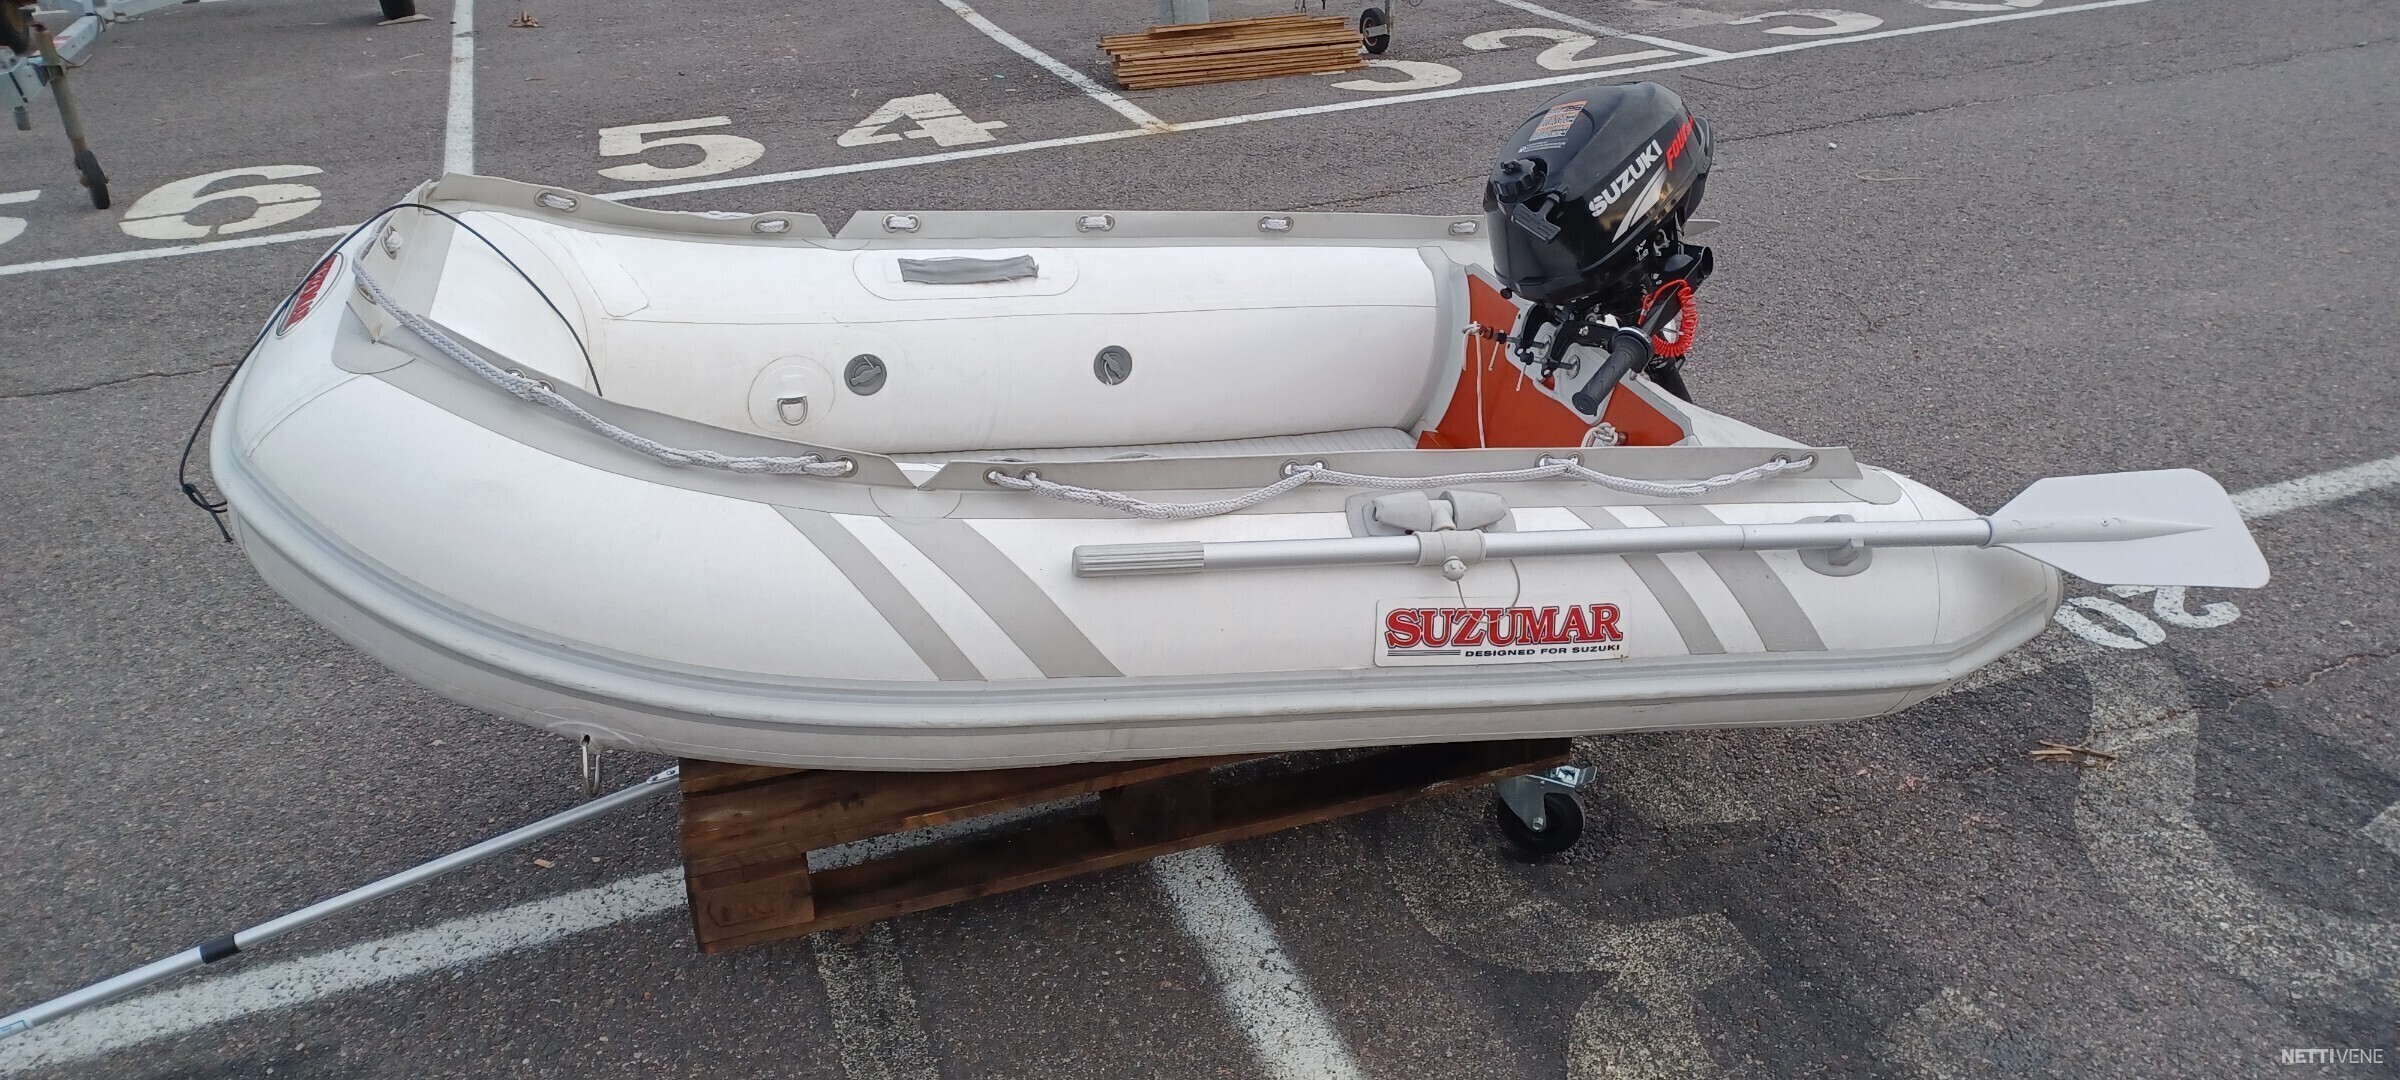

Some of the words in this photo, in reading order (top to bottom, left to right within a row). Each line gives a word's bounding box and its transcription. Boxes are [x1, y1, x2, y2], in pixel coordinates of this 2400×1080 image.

[1589, 139, 1663, 218] SUZUKI
[1384, 603, 1624, 648] SUZUMAR
[1464, 648, 1536, 658] DESIGNED
[1540, 647, 1568, 655] FOR
[1572, 644, 1621, 654] SUZUKI
